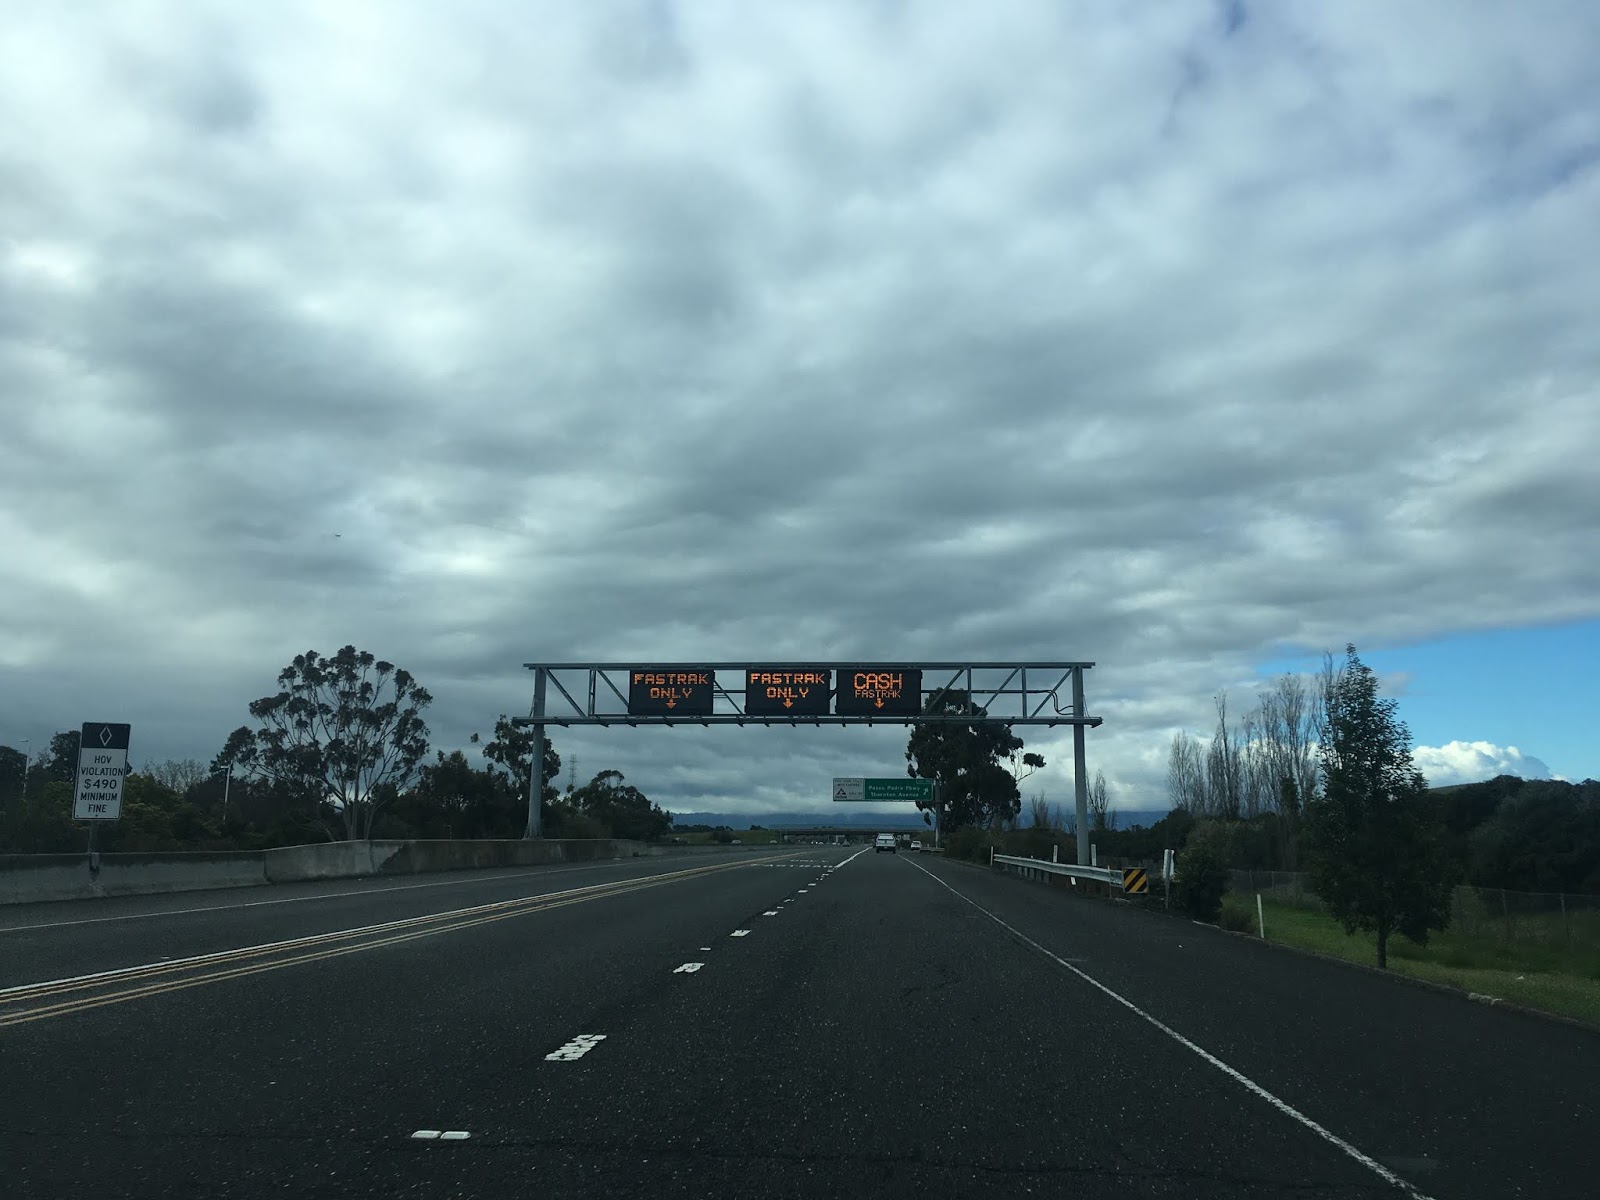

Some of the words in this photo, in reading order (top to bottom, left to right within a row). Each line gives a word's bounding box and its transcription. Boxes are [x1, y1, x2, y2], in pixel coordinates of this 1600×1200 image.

[634, 673, 708, 685] FASTRAK
[750, 673, 825, 685] FASTRAK
[853, 673, 903, 690] CASH
[650, 687, 692, 698] ONLY
[766, 687, 809, 698] ONLY
[854, 689, 901, 698] FASTRAK
[94, 755, 112, 764] HOV
[81, 766, 124, 776] VIOLATION
[83, 778, 117, 790] $490
[80, 792, 118, 801] MINIMUM
[88, 804, 107, 813] FINE
